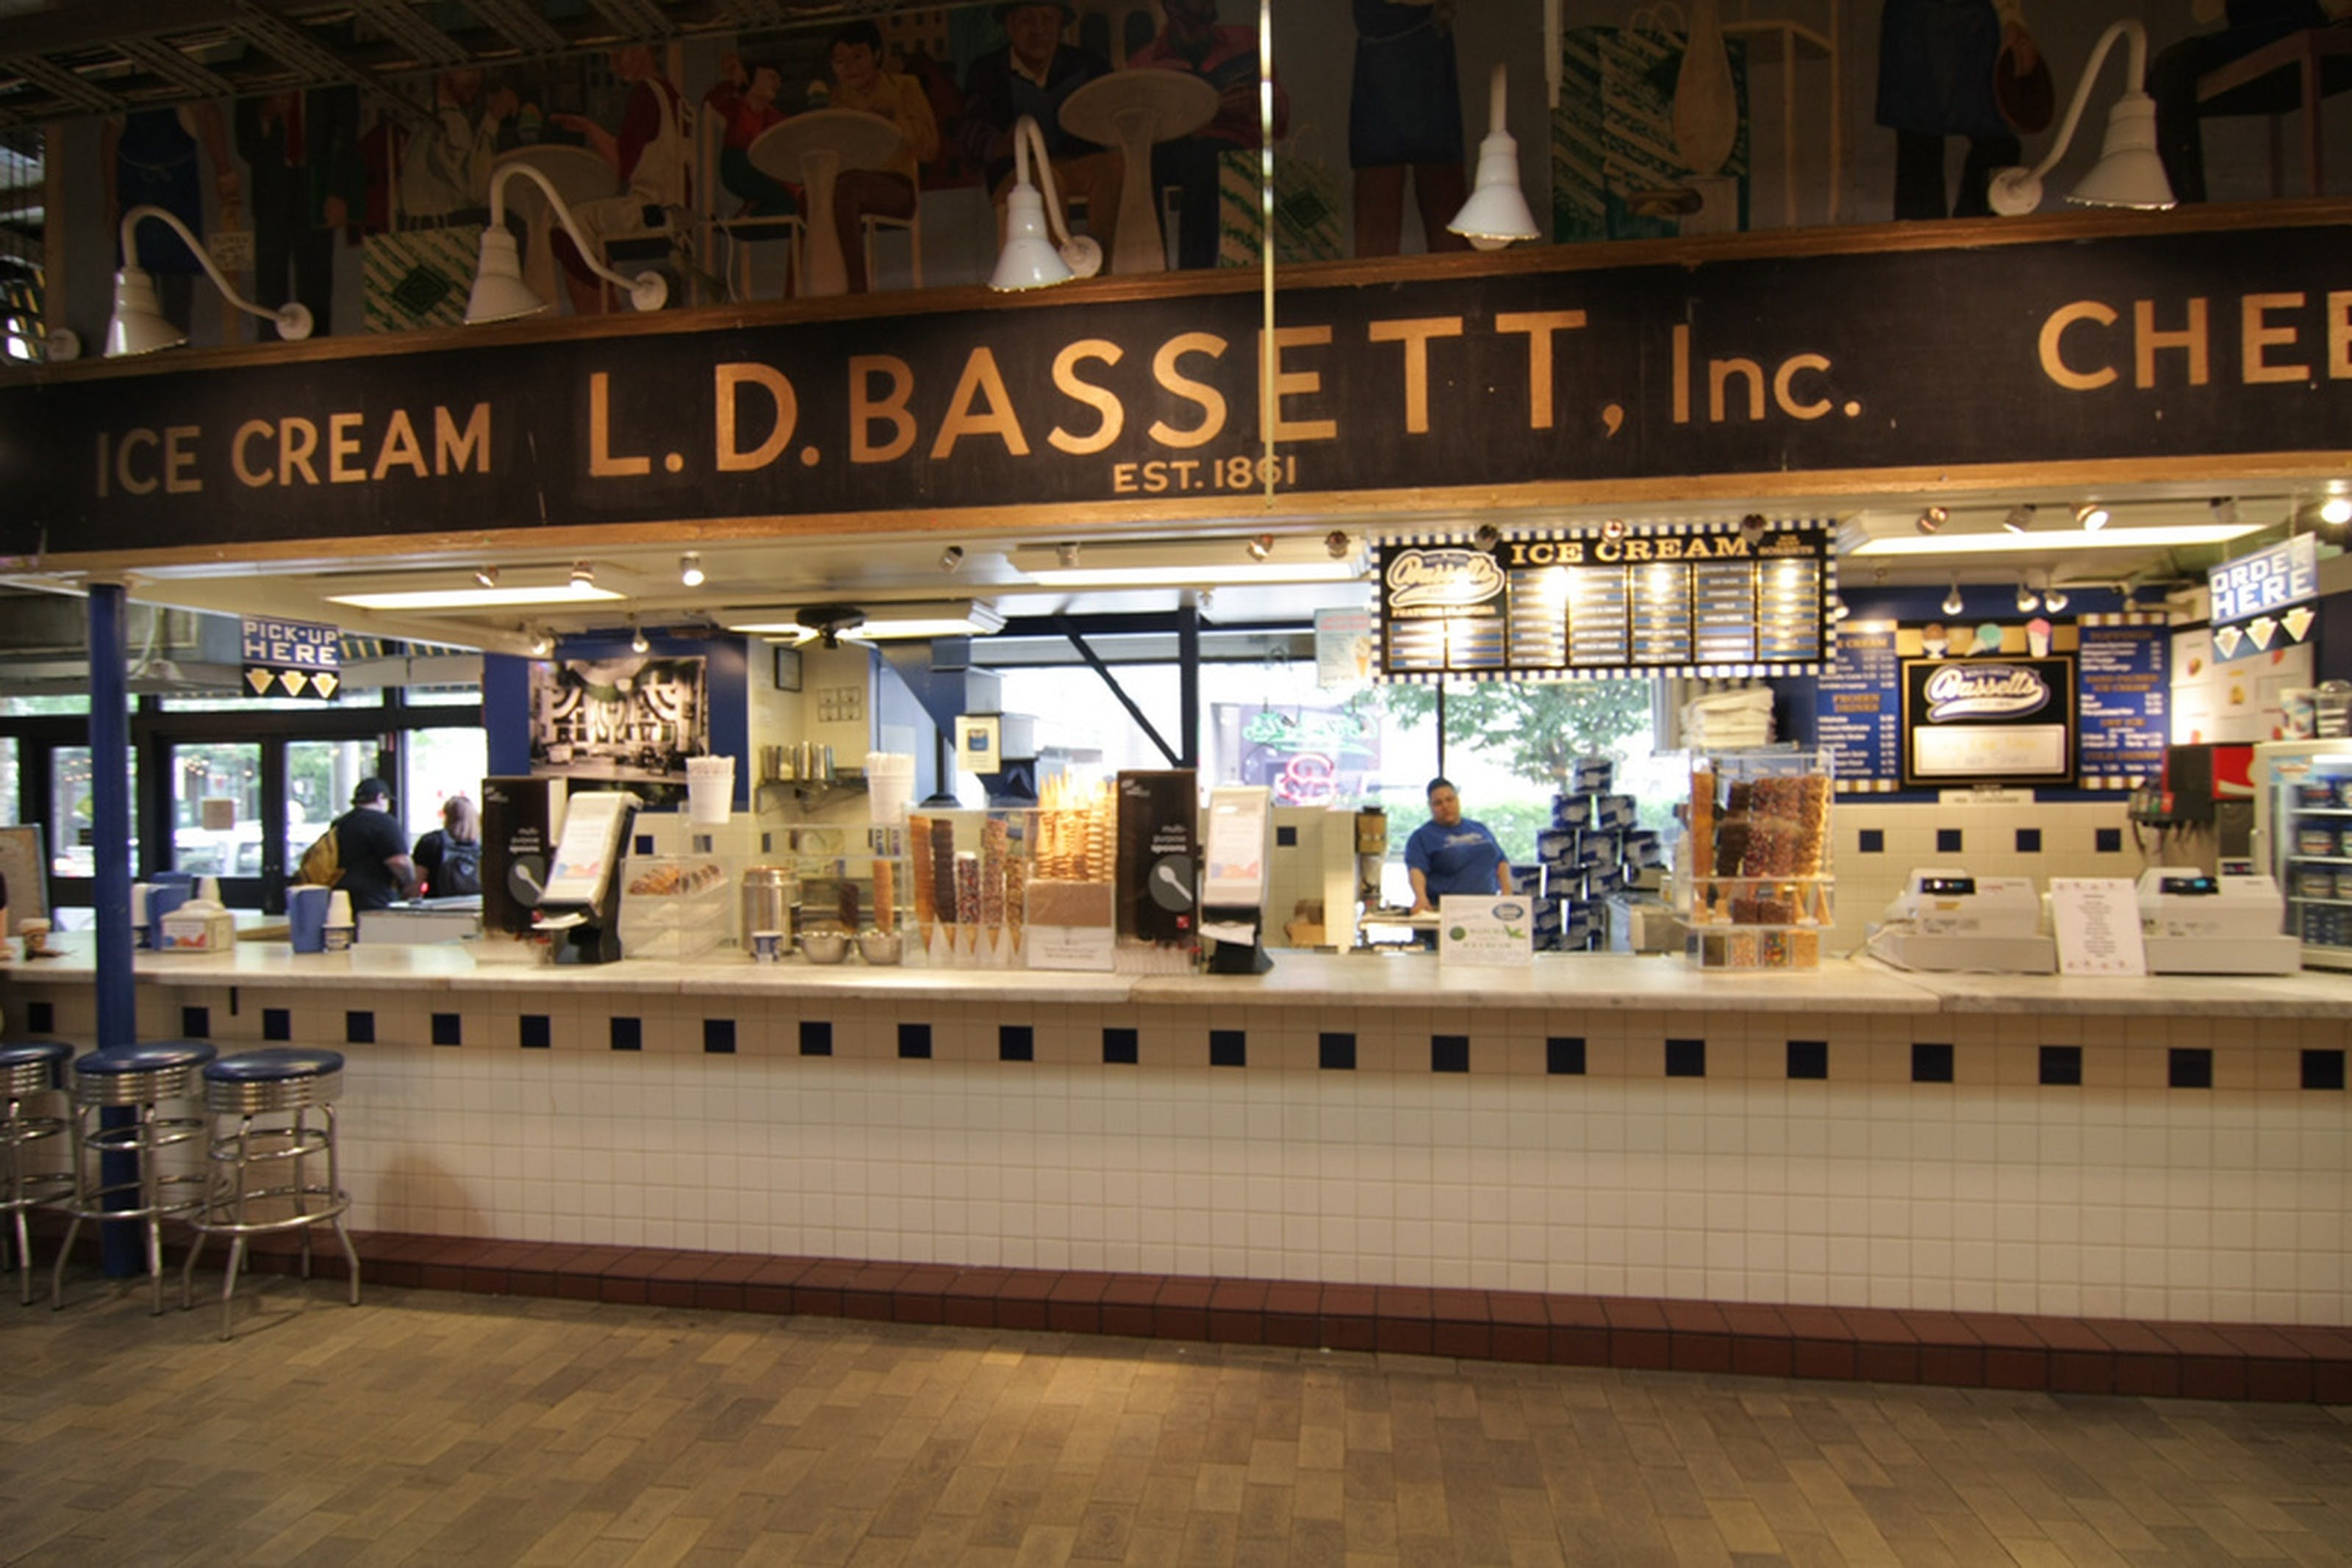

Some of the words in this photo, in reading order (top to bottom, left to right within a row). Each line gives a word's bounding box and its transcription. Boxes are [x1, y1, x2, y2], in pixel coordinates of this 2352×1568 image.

[851, 311, 1624, 463] BASSETT,
[1672, 324, 1862, 423] Inc.
[98, 425, 202, 498] ICE
[232, 402, 491, 488] CREAM
[1511, 542, 1584, 564] ICE
[1596, 536, 1750, 561] CREAM
[2211, 546, 2310, 594] ORDER
[2212, 566, 2314, 620] HERE
[243, 622, 338, 646] PICK-UP
[244, 639, 337, 665] HERE
